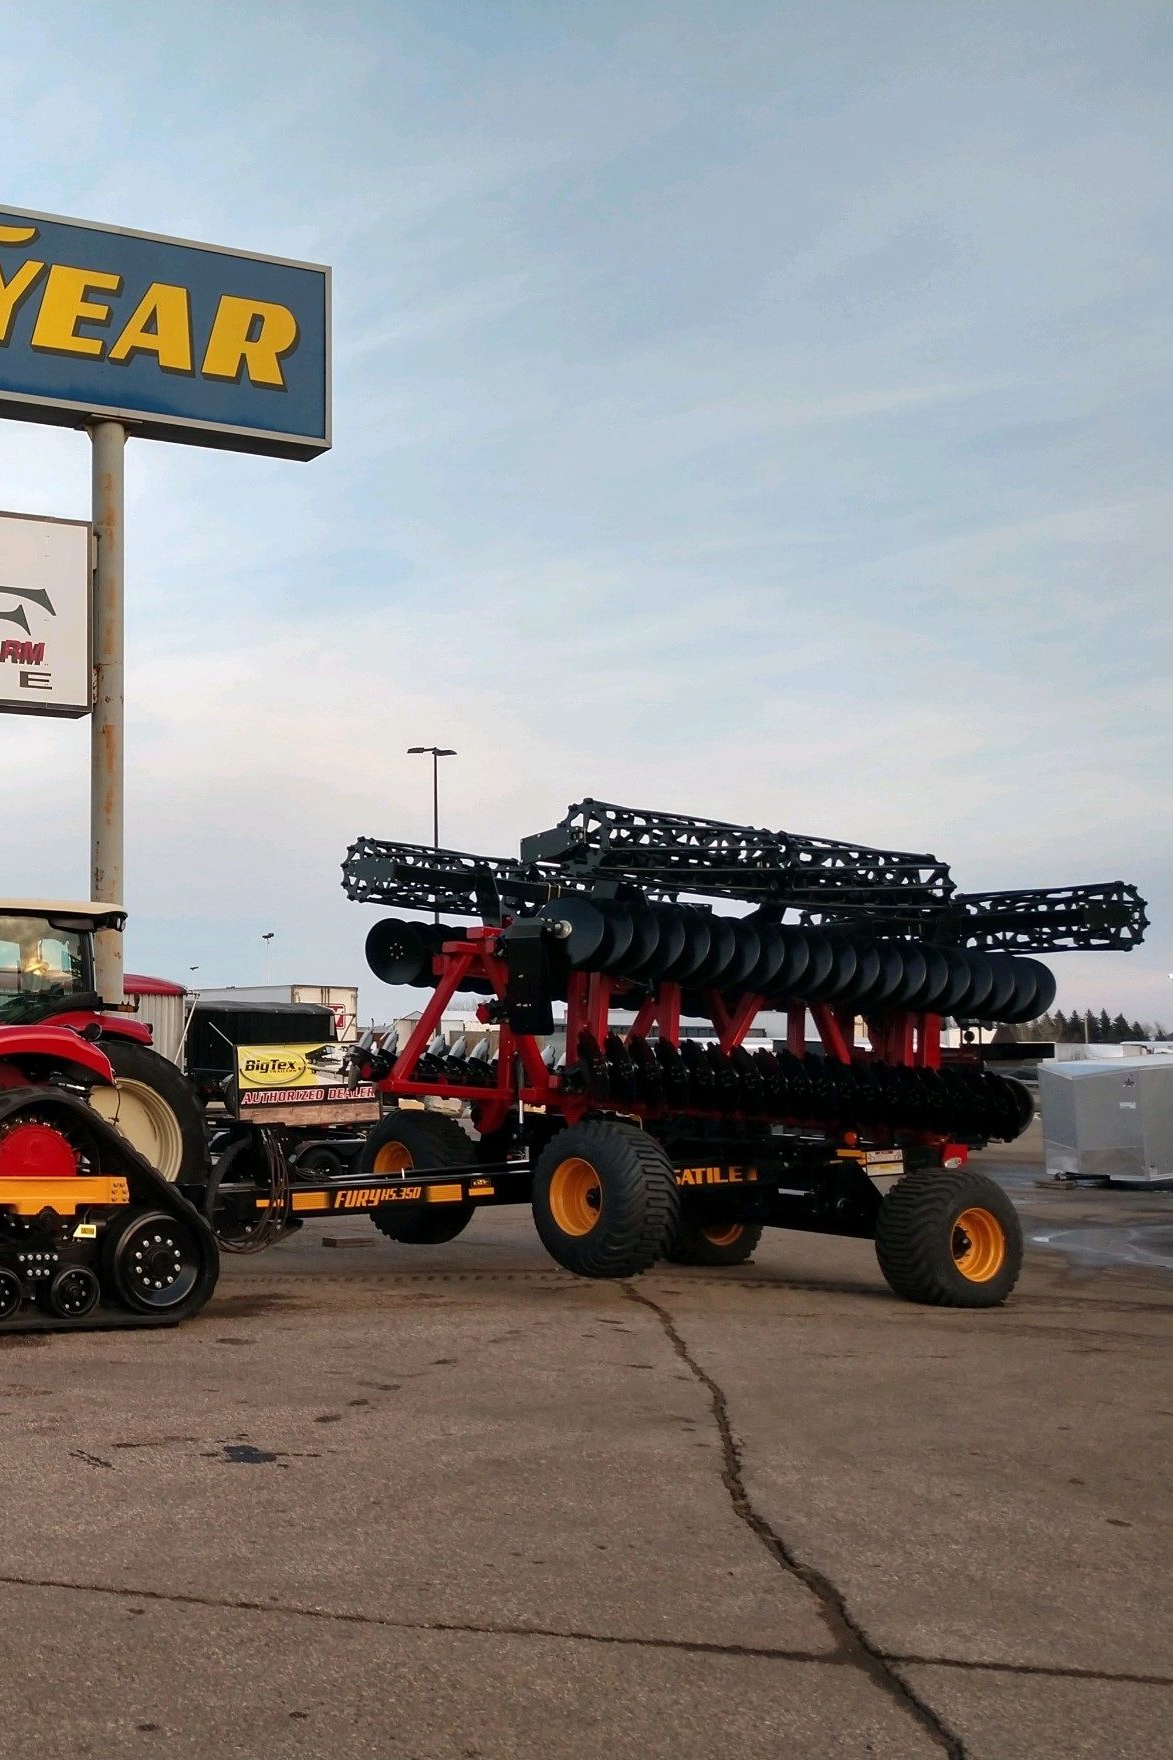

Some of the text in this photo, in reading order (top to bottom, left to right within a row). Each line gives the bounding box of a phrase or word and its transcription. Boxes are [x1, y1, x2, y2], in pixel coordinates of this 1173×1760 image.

[244, 1058, 297, 1074] BigTex
[241, 1086, 376, 1105] AUTHORIZED DEALER
[333, 1188, 381, 1209] FURY
